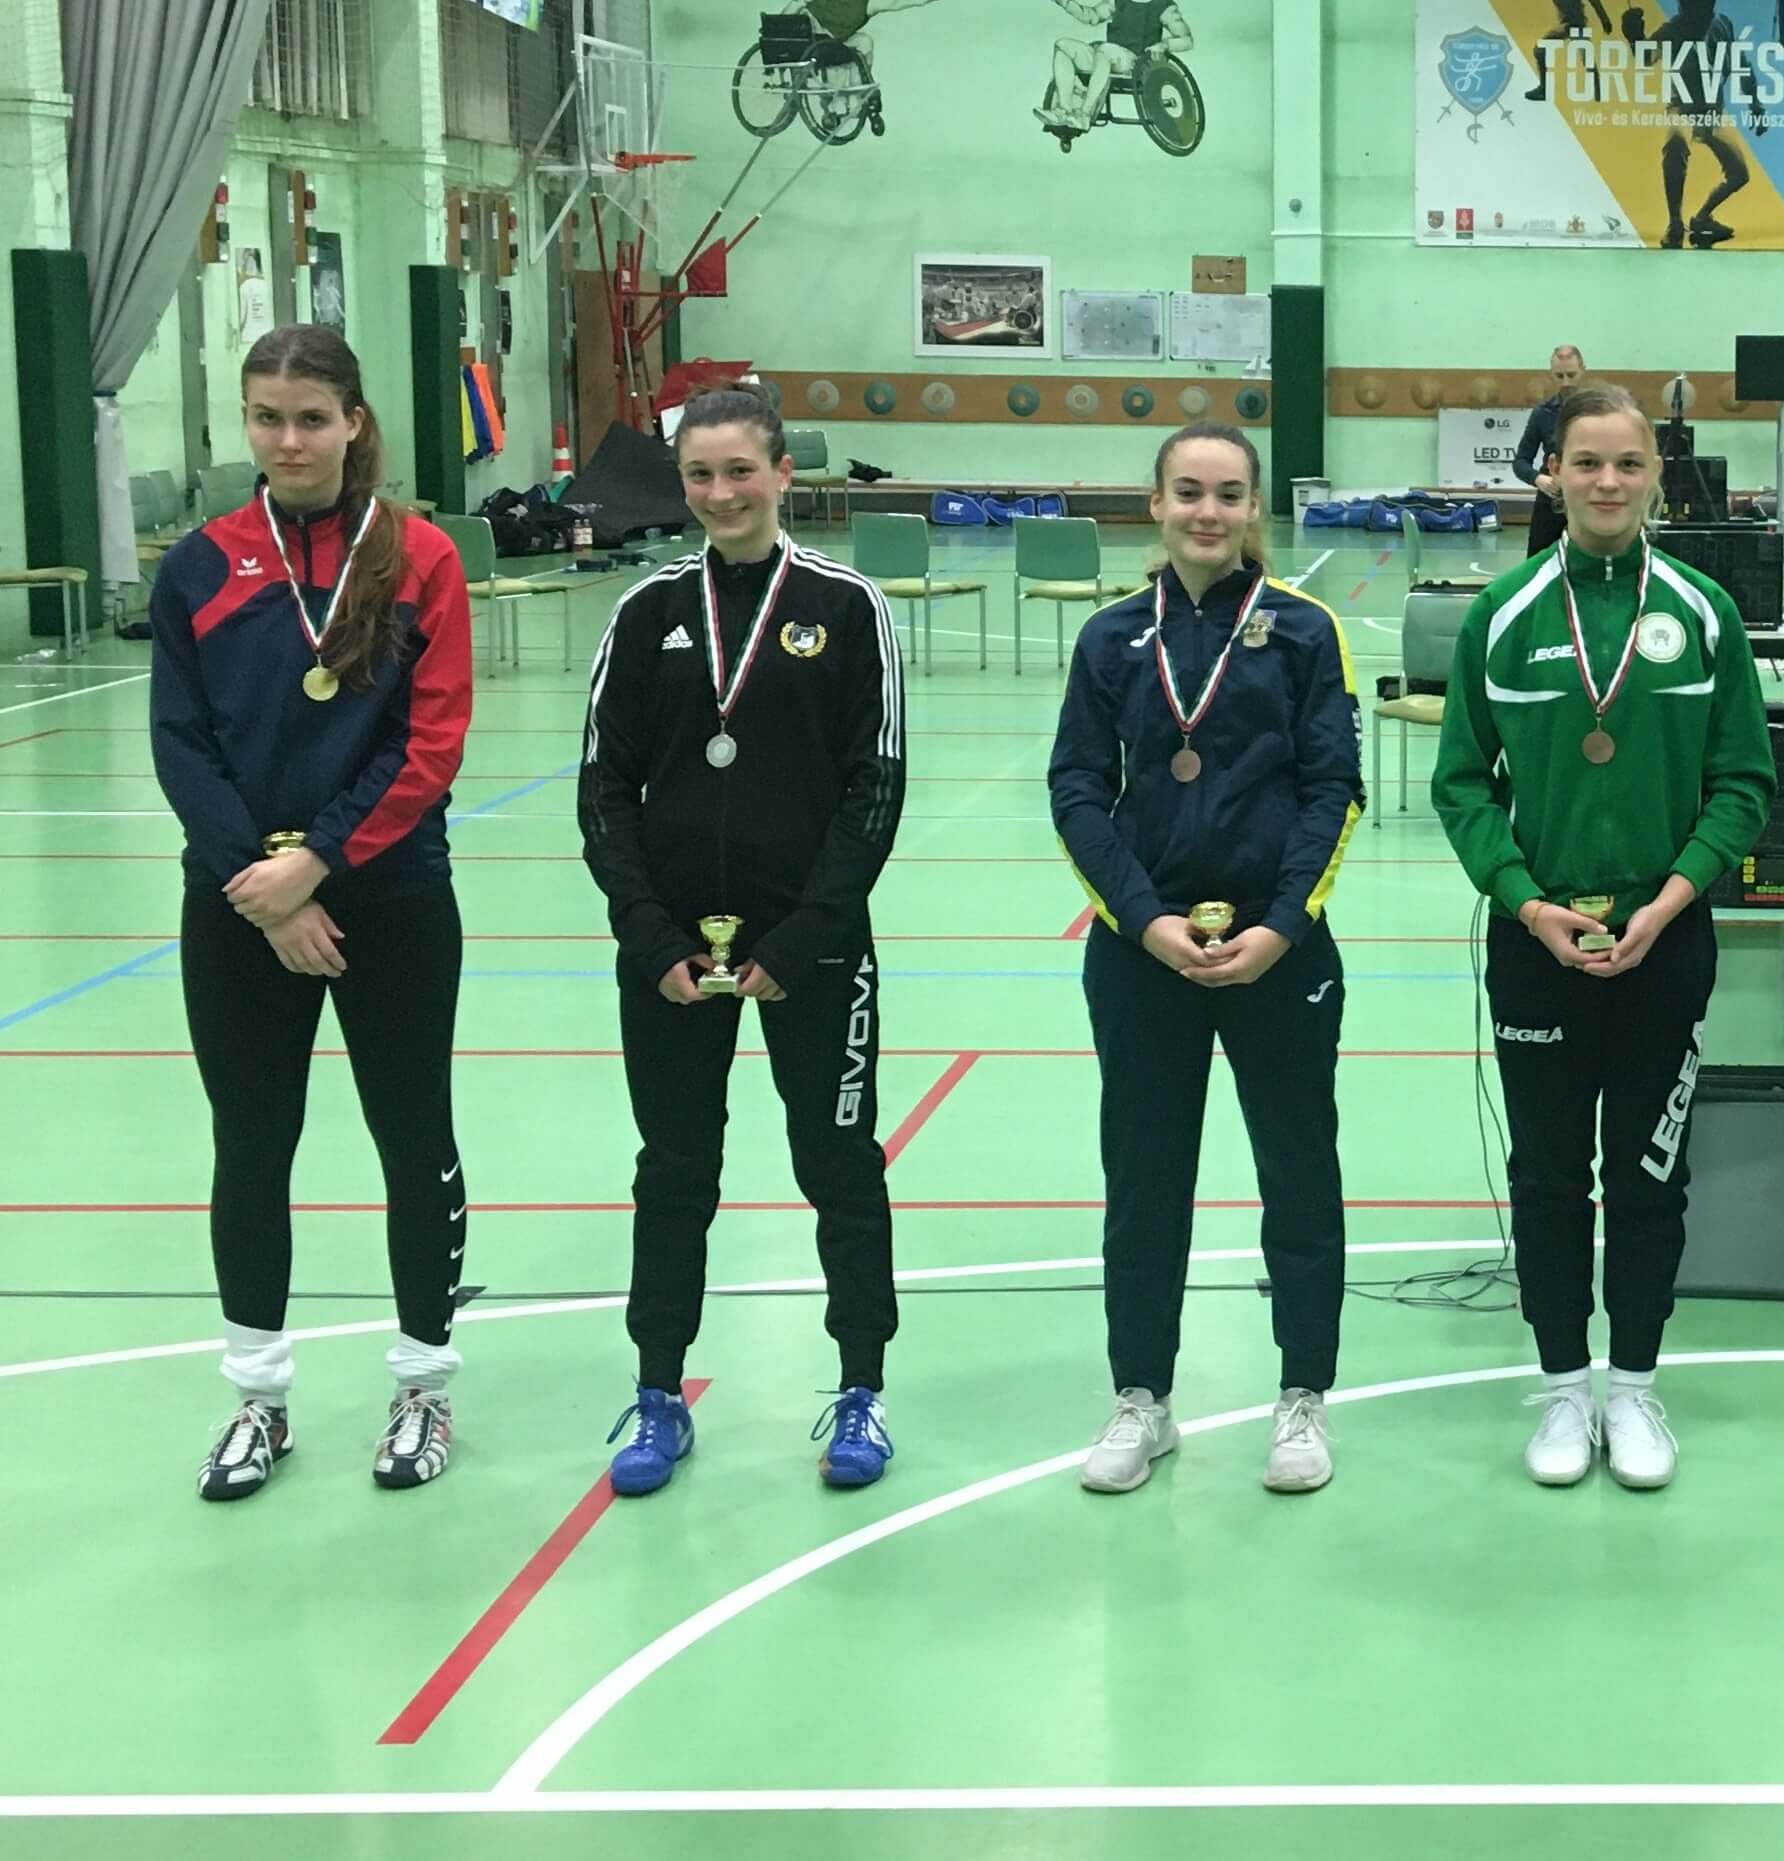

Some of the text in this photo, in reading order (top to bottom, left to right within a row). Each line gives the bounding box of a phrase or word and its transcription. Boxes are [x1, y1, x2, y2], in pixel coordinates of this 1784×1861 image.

[1536, 26, 1784, 105] TÖREKVÉS
[1631, 109, 1737, 127] Kerekesszékes
[1497, 420, 1510, 428] LG
[1473, 447, 1500, 459] LED
[1527, 645, 1577, 664] LEGE
[1495, 1021, 1563, 1044] LEGEA
